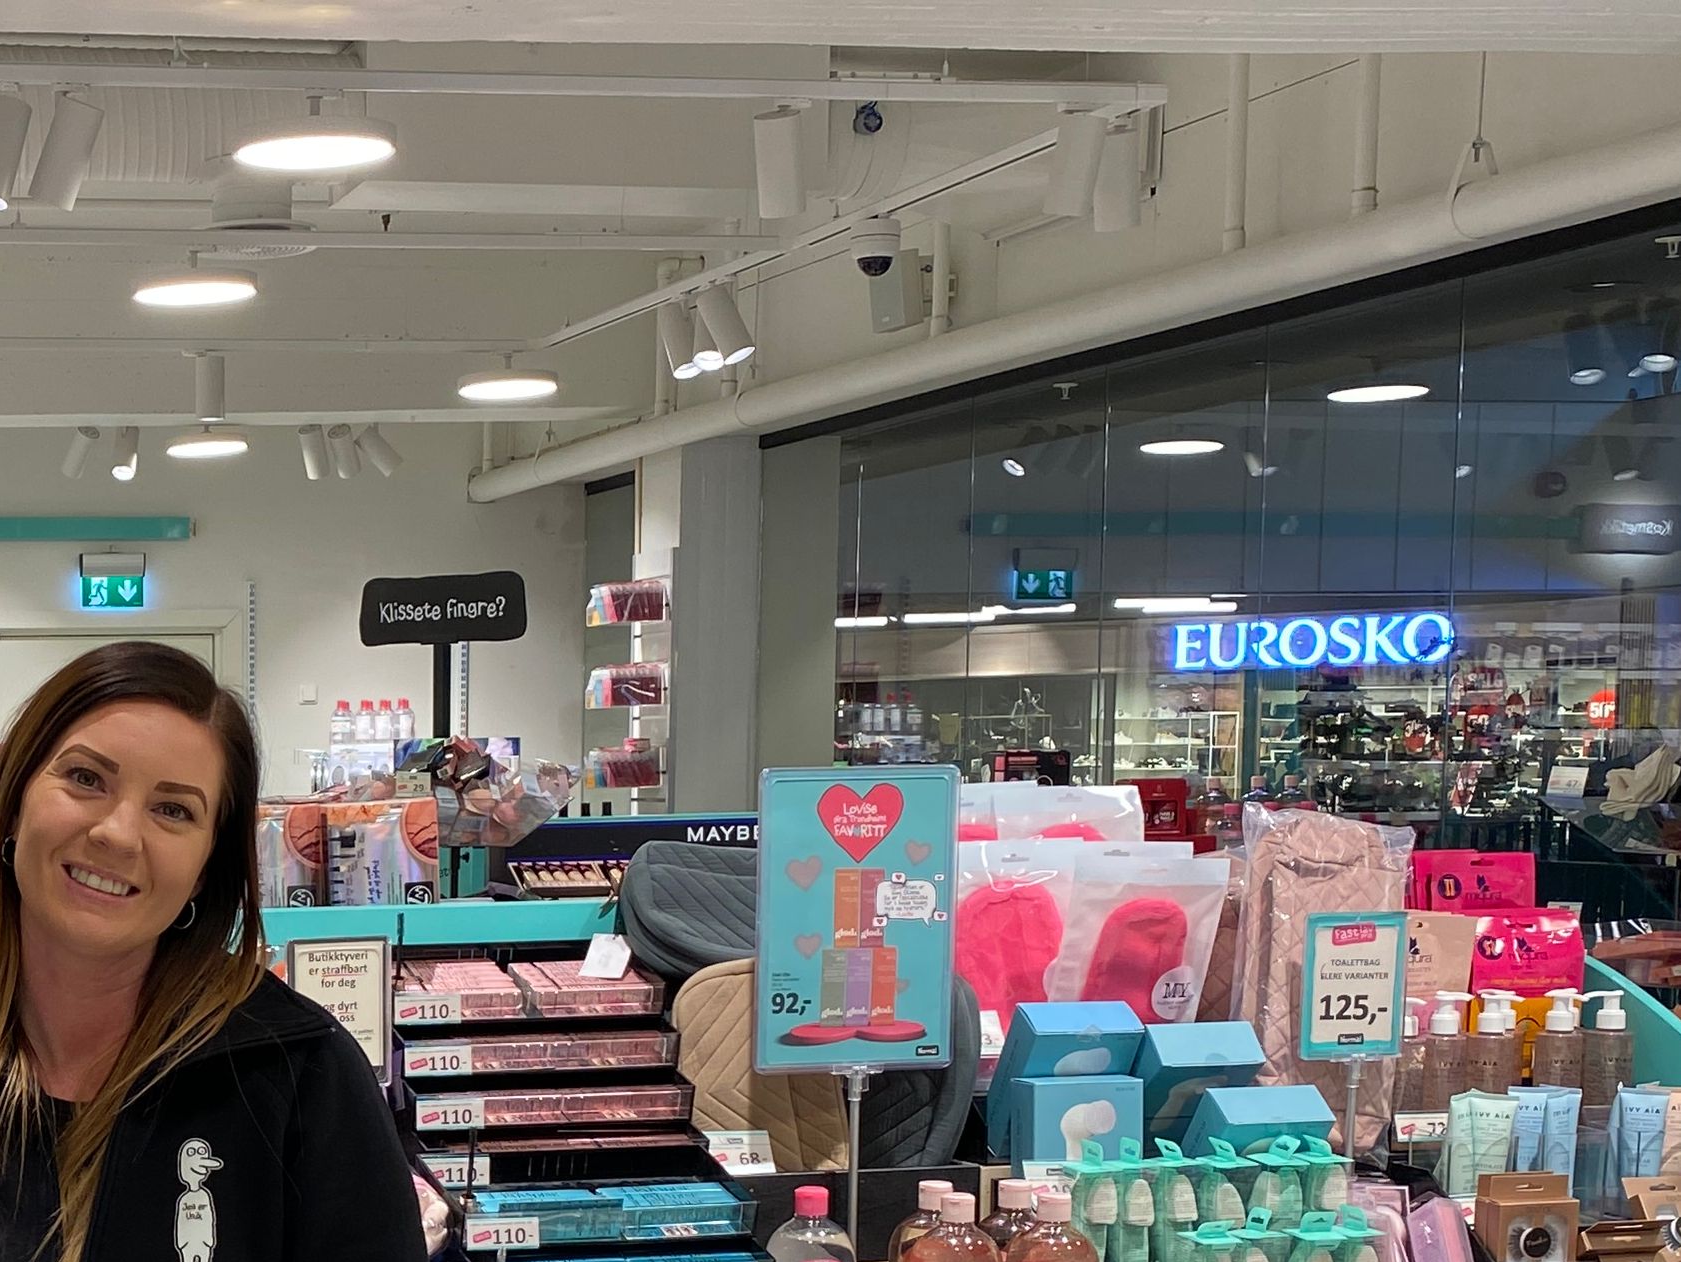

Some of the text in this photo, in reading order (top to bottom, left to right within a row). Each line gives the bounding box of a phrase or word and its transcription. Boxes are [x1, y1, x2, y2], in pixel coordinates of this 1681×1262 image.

[379, 596, 506, 623] Klissete fingre?
[1175, 612, 1455, 669] EUROSKO
[308, 951, 368, 964] Butikktyveri
[309, 964, 368, 975] er straffbart
[1345, 971, 1389, 981] VARIANTER
[321, 978, 356, 989] for deg
[337, 1001, 358, 1014] dyrt
[771, 992, 811, 1016] 92,-
[1319, 994, 1388, 1024] 125,-
[339, 1014, 355, 1022] oss
